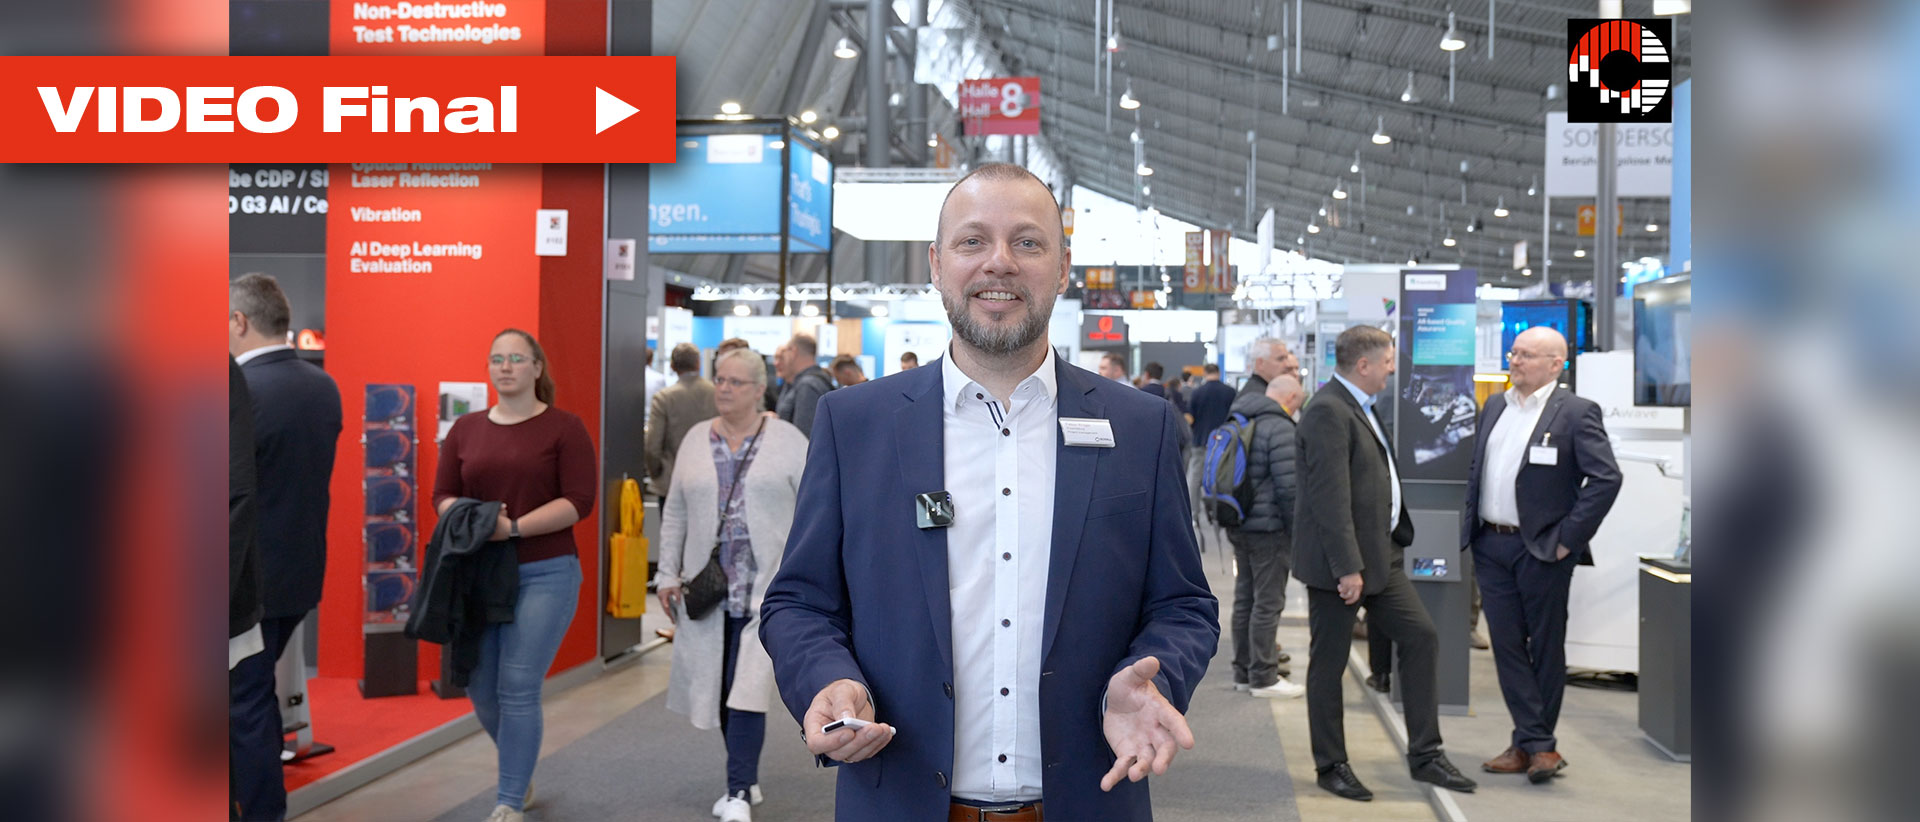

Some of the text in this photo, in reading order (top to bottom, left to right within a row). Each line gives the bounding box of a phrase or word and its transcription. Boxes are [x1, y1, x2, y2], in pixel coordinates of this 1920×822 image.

[353, 1, 507, 20] Non-Destructive
[353, 23, 521, 44] Test Technologies
[962, 82, 1023, 117] Halle 8
[962, 103, 990, 117] Hall
[254, 169, 296, 188] CDP
[297, 170, 307, 189] /
[352, 172, 479, 187] Laser Reflection
[241, 195, 267, 214] G3
[269, 195, 289, 214] AI
[291, 195, 302, 215] /
[350, 206, 421, 222] Vibration
[350, 240, 482, 259] AI Deep Learning
[350, 257, 432, 273] Evaluation
